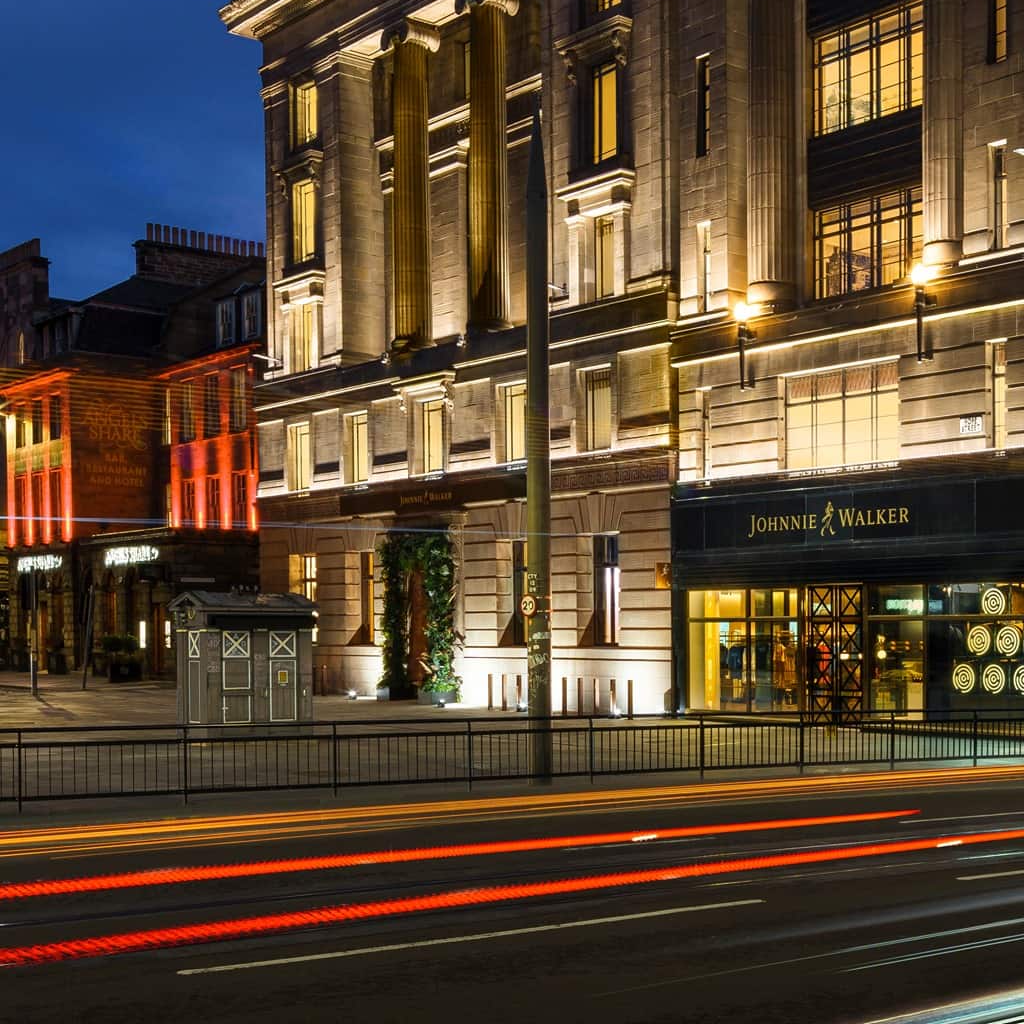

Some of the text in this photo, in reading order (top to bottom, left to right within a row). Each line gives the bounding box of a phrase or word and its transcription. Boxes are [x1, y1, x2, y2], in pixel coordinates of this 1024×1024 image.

[114, 477, 145, 487] HOTEL
[748, 507, 910, 538] JOHNNIE WALKER
[522, 601, 534, 611] 20
